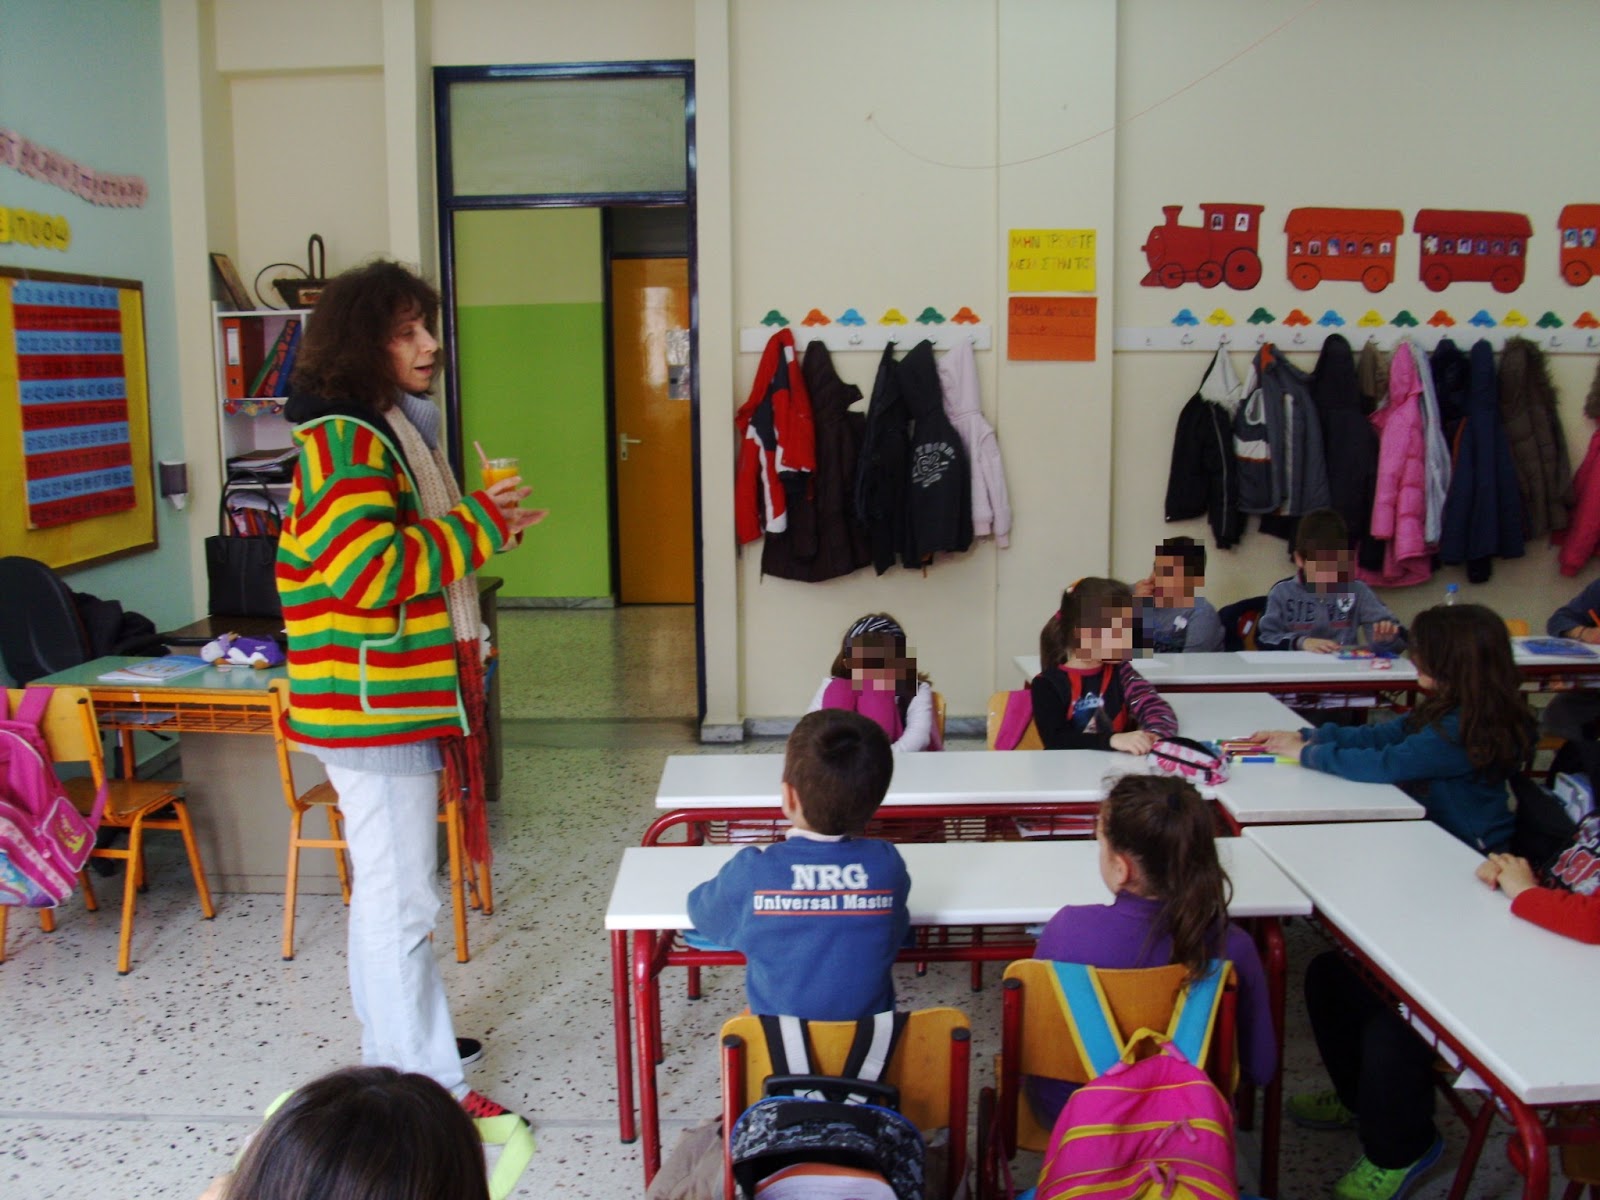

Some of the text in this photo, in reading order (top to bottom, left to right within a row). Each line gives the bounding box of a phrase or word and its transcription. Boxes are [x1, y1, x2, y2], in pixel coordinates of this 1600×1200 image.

[791, 863, 869, 890] NRG
[753, 894, 894, 911] Universal Master
